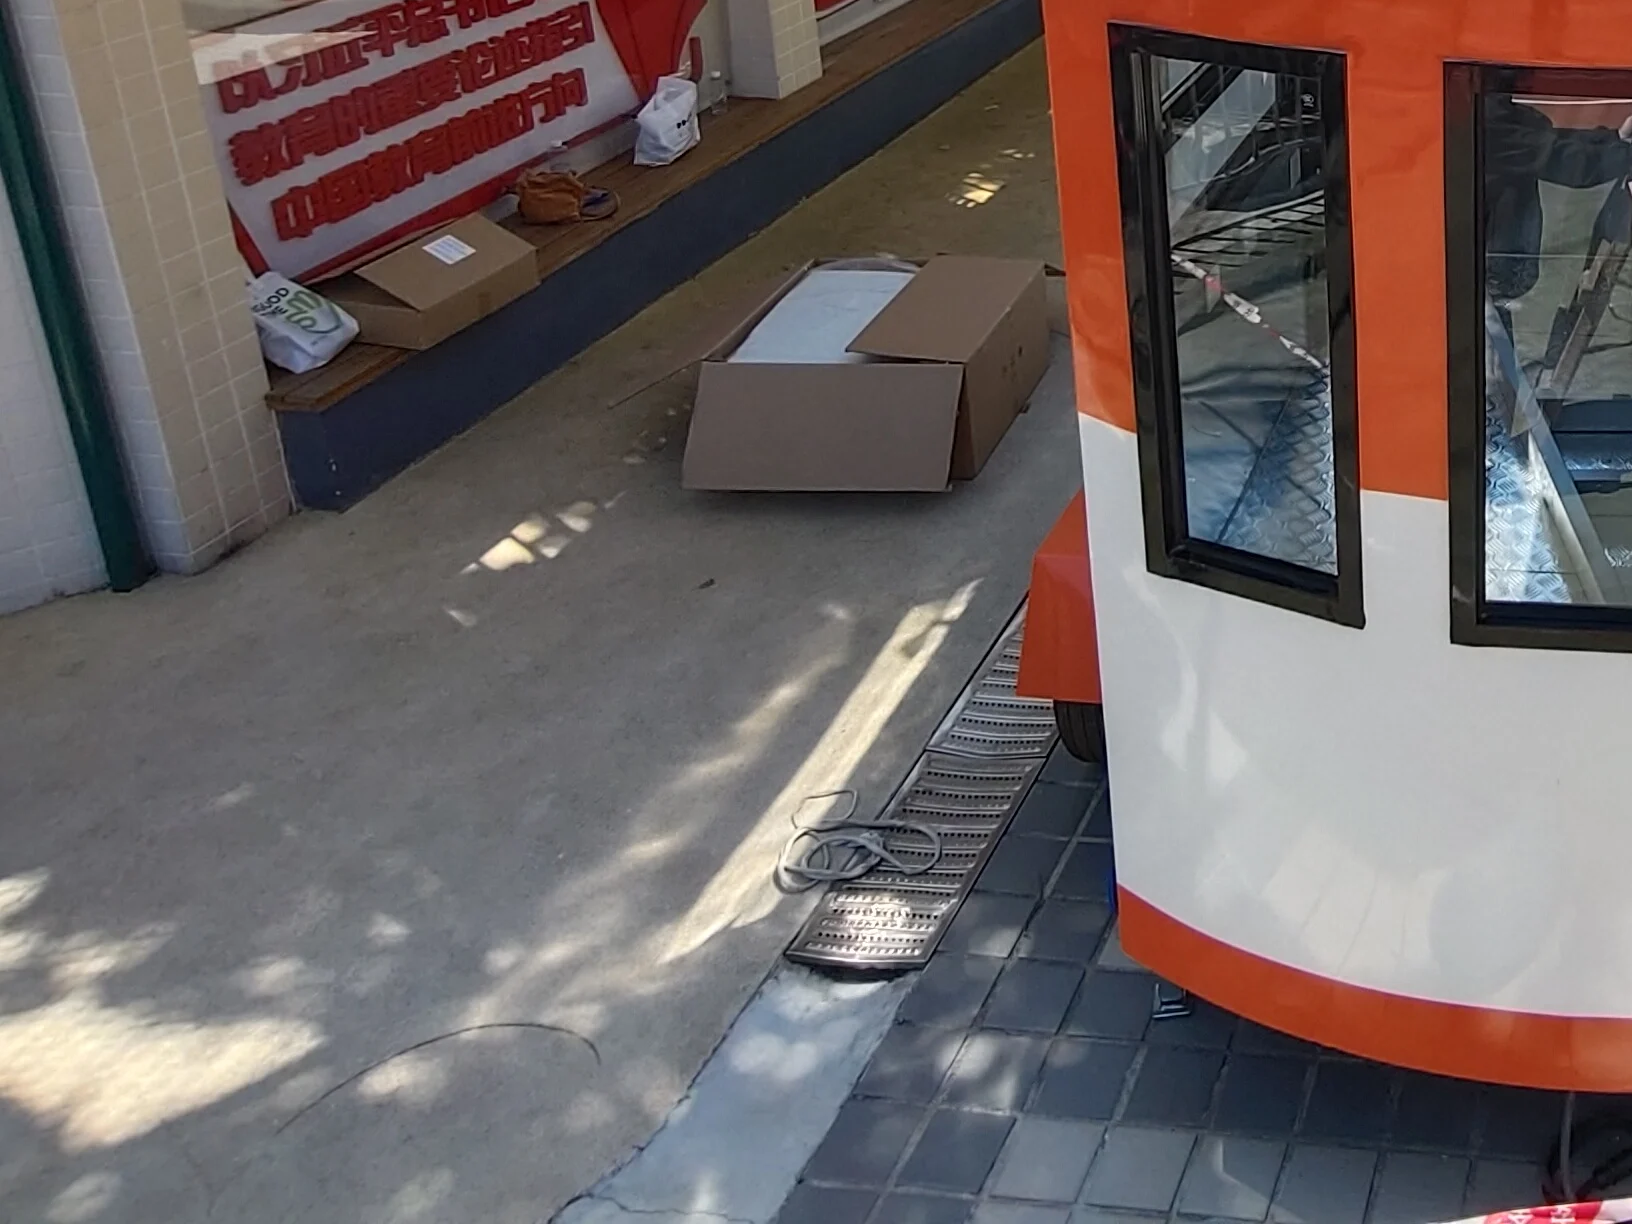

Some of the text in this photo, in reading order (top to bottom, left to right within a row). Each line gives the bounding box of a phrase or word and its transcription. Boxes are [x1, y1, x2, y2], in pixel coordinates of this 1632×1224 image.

[228, 1, 595, 186] 教育的重要论述指引
[270, 68, 589, 242] 中国教育前进方向
